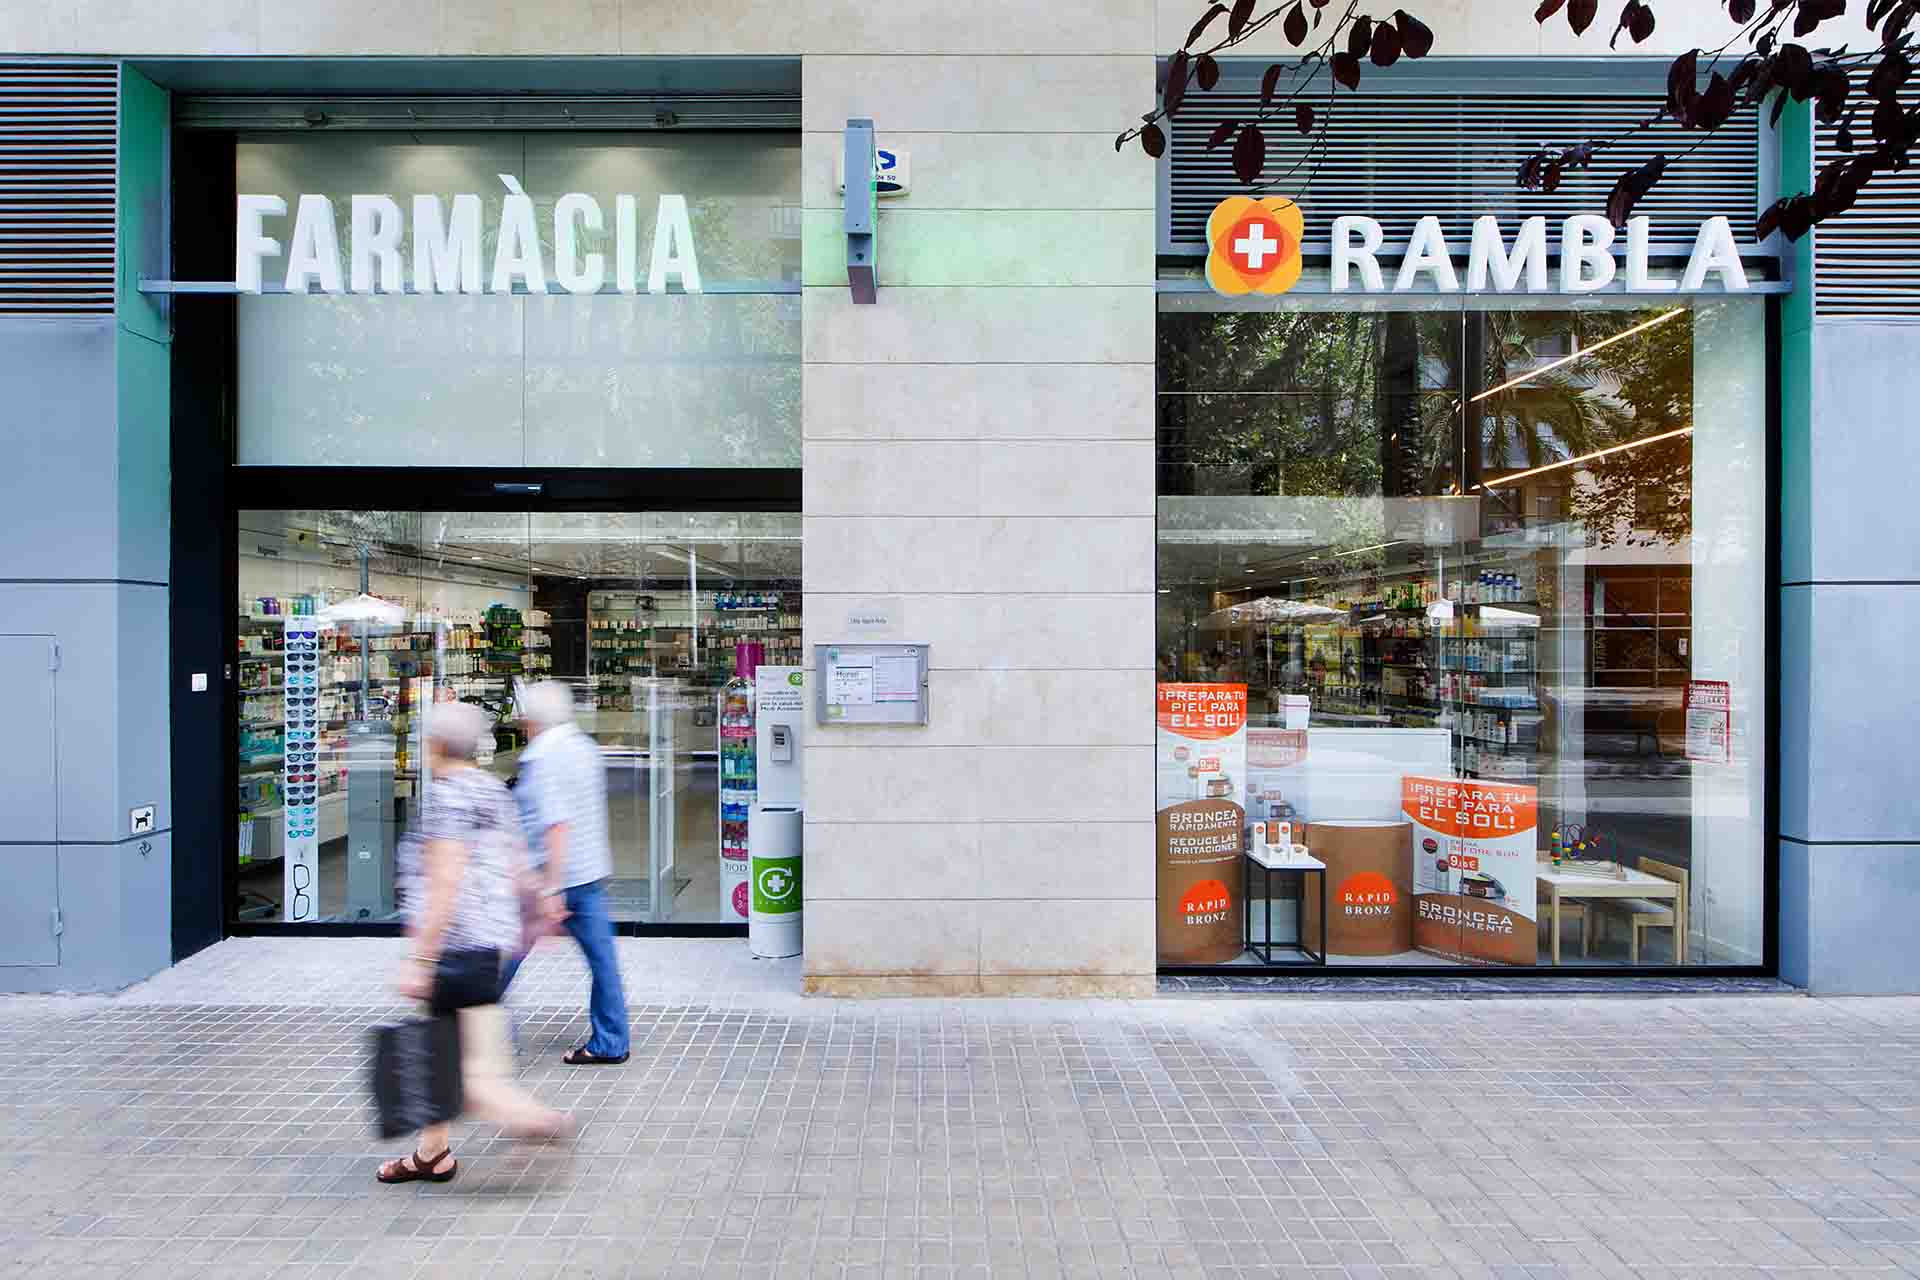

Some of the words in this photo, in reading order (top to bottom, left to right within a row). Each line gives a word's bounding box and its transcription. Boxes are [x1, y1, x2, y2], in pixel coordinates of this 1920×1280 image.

[236, 174, 702, 294] FARMÀCIA
[1331, 214, 1750, 294] RAMBLA
[1171, 703, 1207, 712] PIEL
[1211, 702, 1239, 712] PARA
[1171, 714, 1200, 727] EL
[1420, 795, 1457, 809] PIEL
[1464, 800, 1513, 813] PARA
[1504, 791, 1527, 804] TU
[1170, 809, 1238, 823] BRONCEA
[1420, 806, 1447, 822] EL
[1456, 811, 1516, 830] SOL!
[1169, 837, 1219, 847] REDUCE
[1221, 833, 1238, 844] LAS
[1345, 891, 1390, 902] RAPID
[1186, 899, 1226, 912] RAPID
[1345, 905, 1391, 915] BRONZ
[1187, 912, 1226, 924] BRONZ
[1419, 900, 1512, 926] BRONCEA
